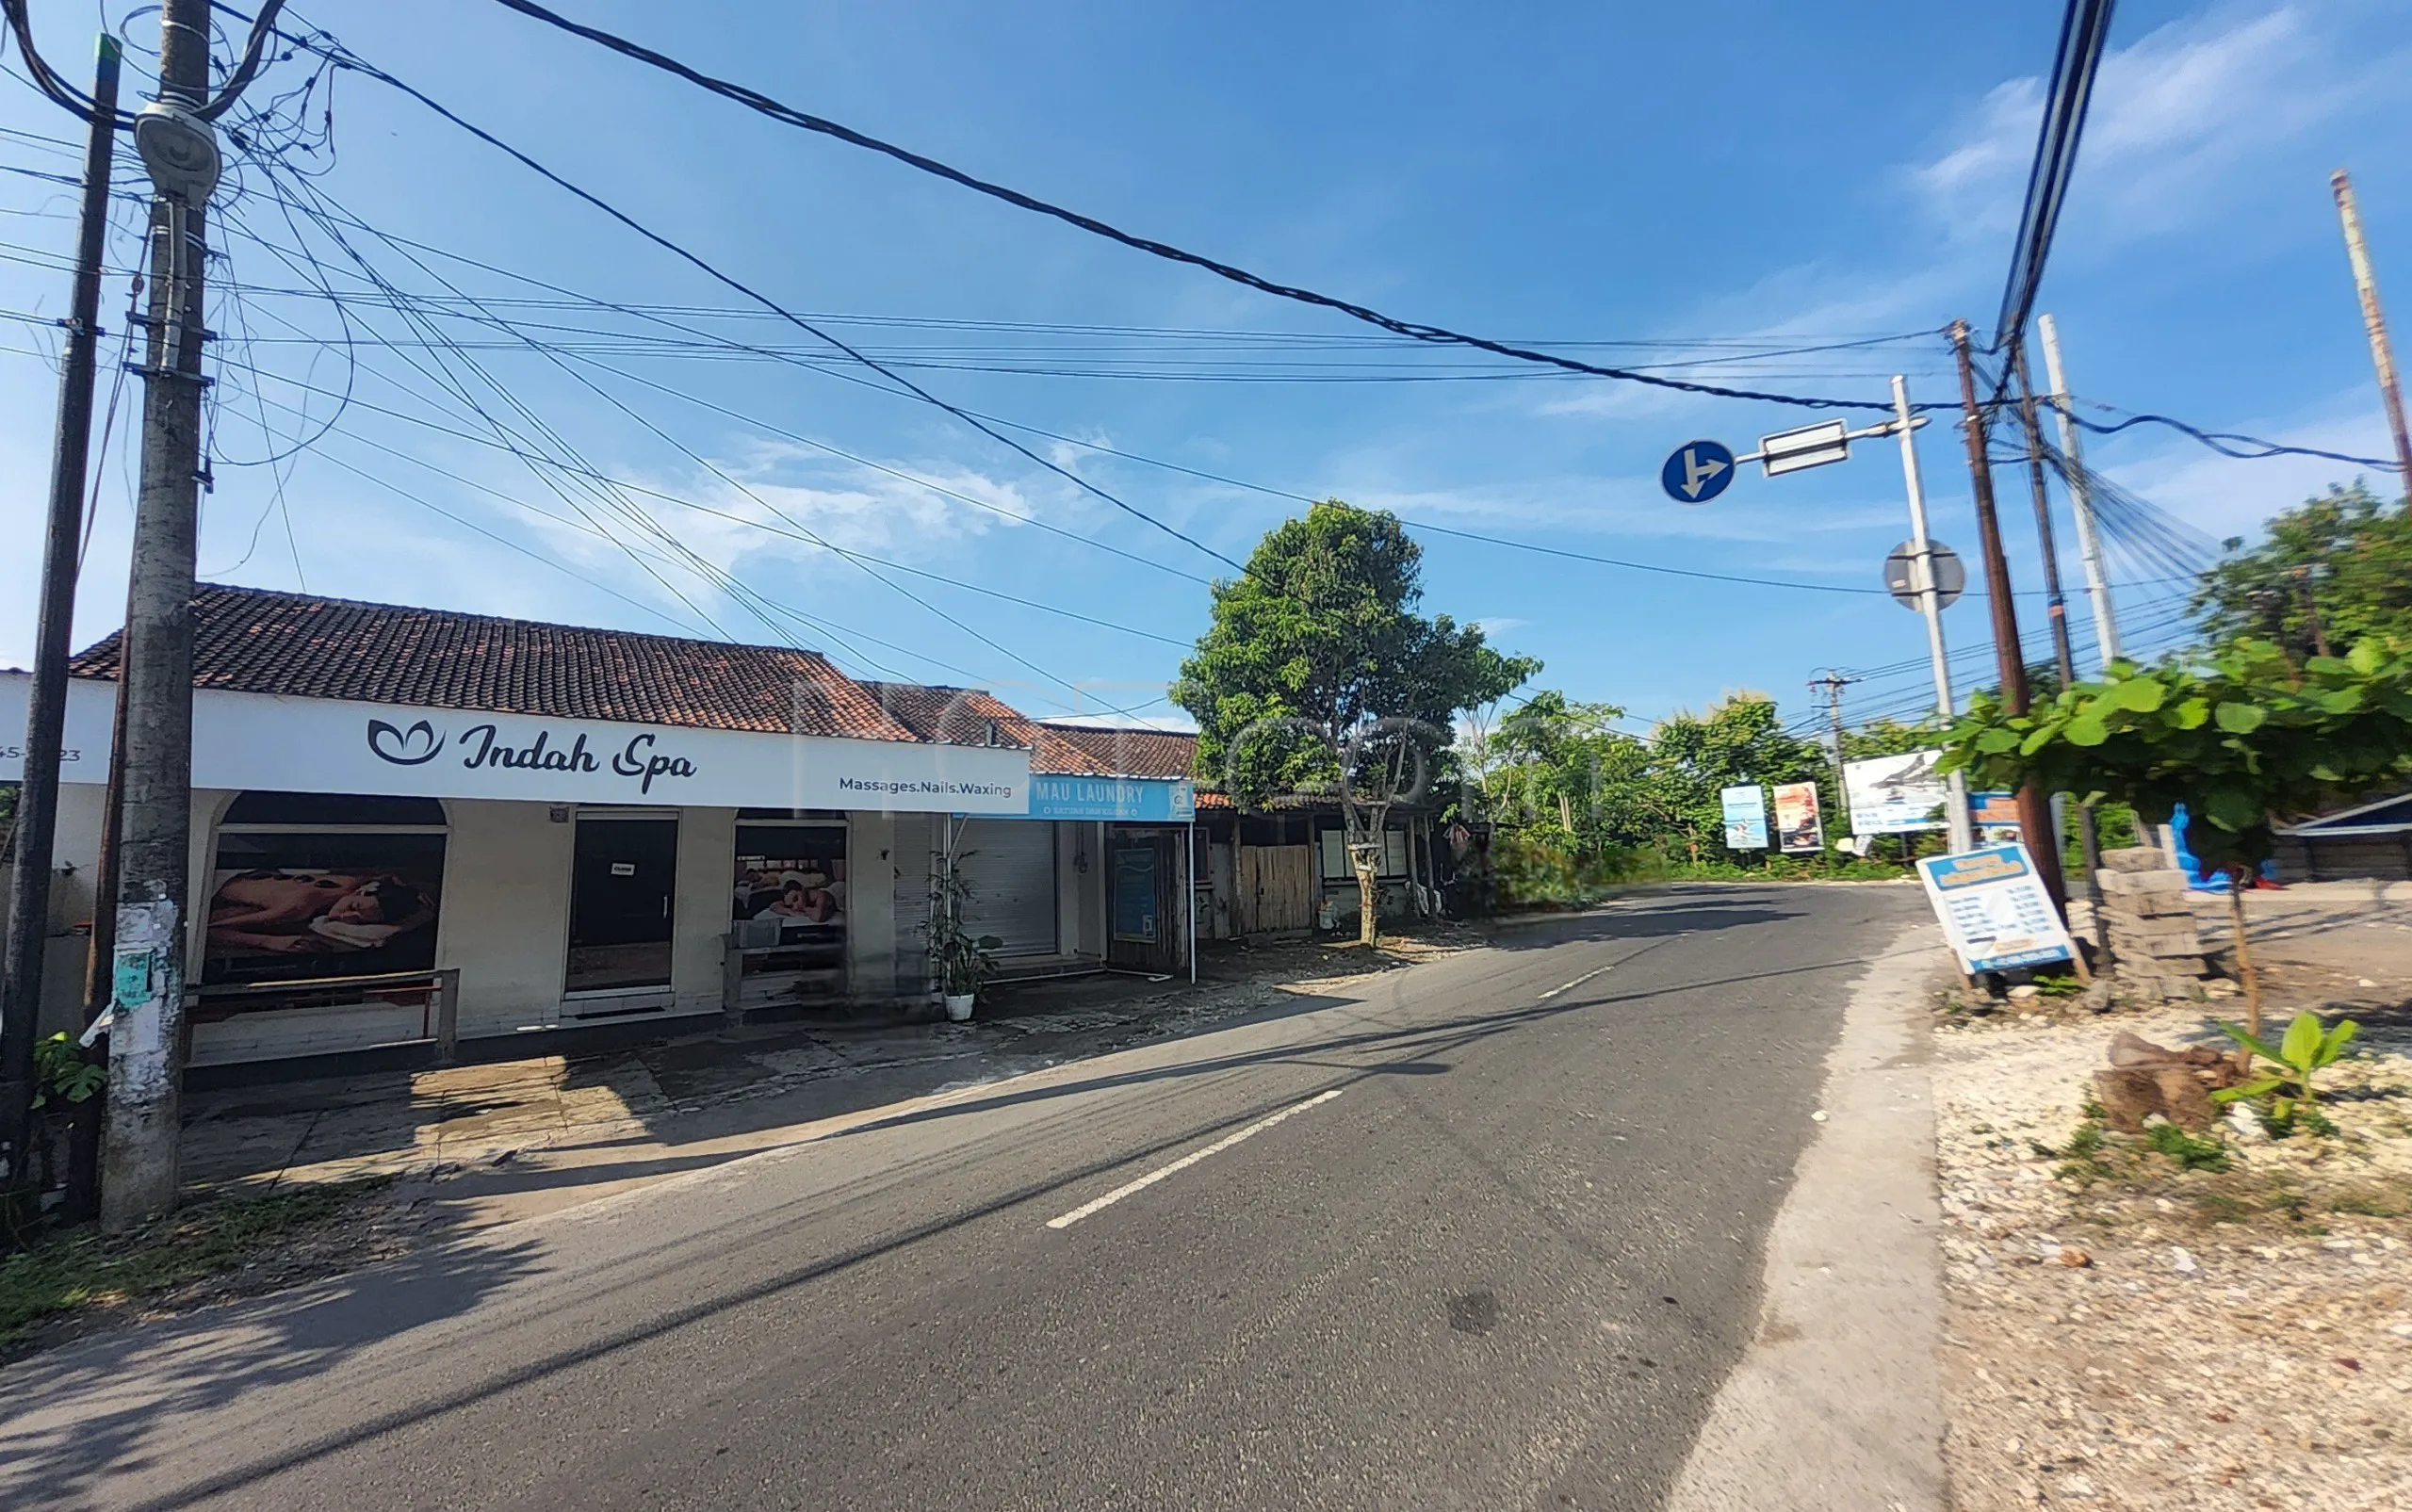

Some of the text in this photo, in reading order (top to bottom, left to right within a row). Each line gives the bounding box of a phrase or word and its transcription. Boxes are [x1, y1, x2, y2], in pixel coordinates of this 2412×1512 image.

[458, 723, 697, 795] Indah Spa
[839, 777, 1012, 799] Massages.Nails.Waxing
[1036, 781, 1144, 804] MAU LAUNDRY
